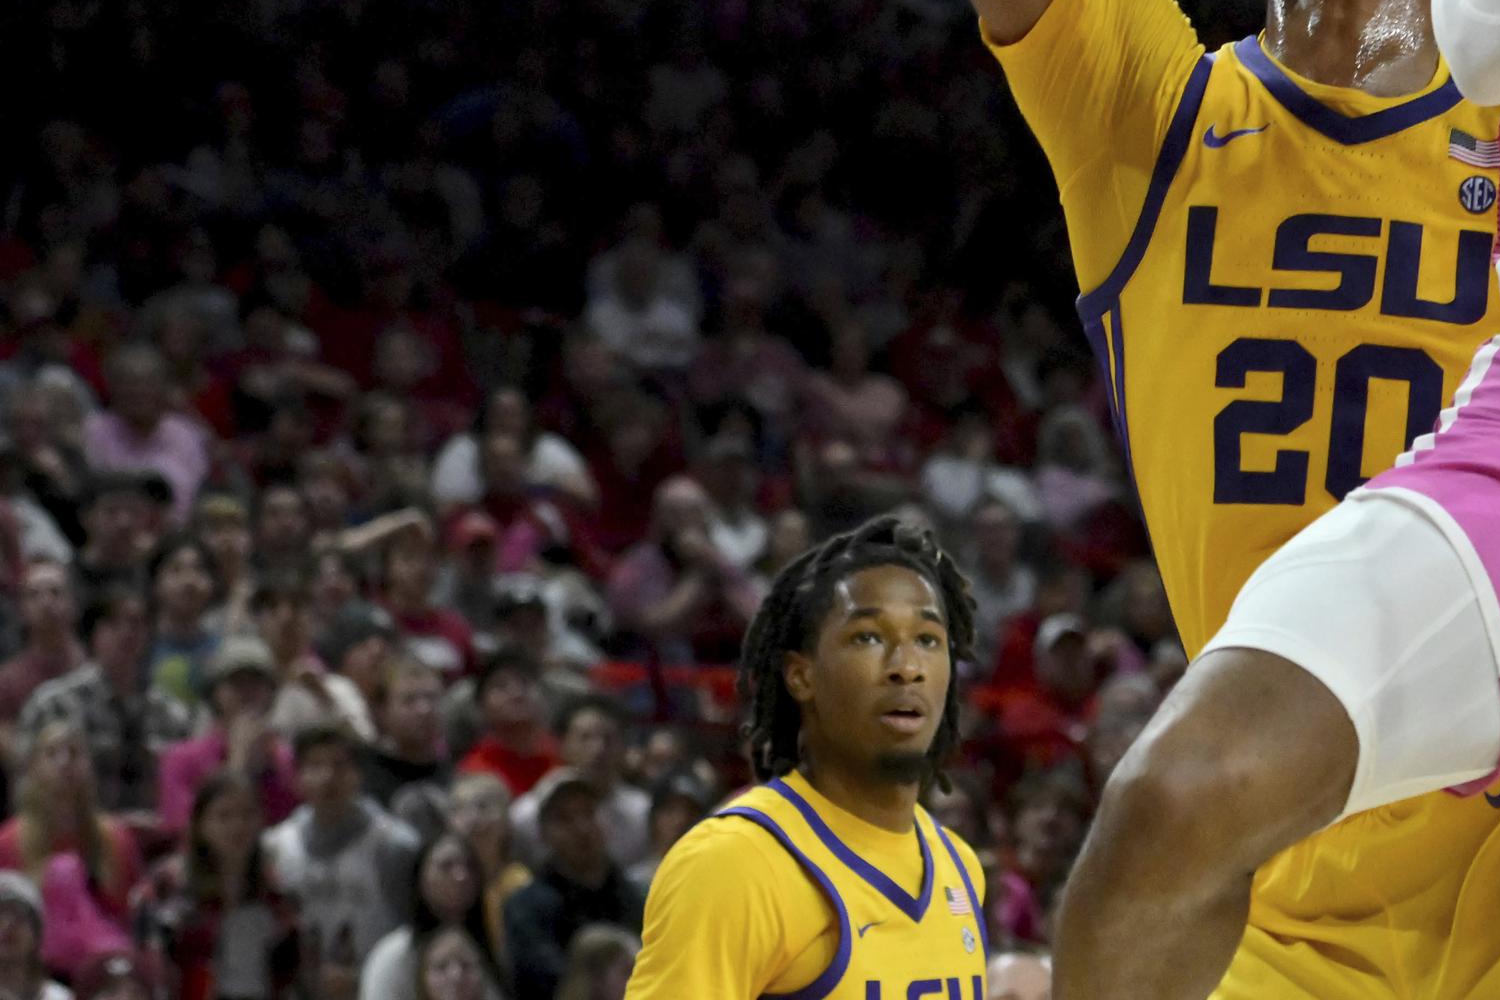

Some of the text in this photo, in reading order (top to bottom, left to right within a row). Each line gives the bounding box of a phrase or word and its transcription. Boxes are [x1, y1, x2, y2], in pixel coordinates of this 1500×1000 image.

[1462, 177, 1494, 210] SEC
[1182, 205, 1494, 326] LSU
[1213, 337, 1444, 506] 20
